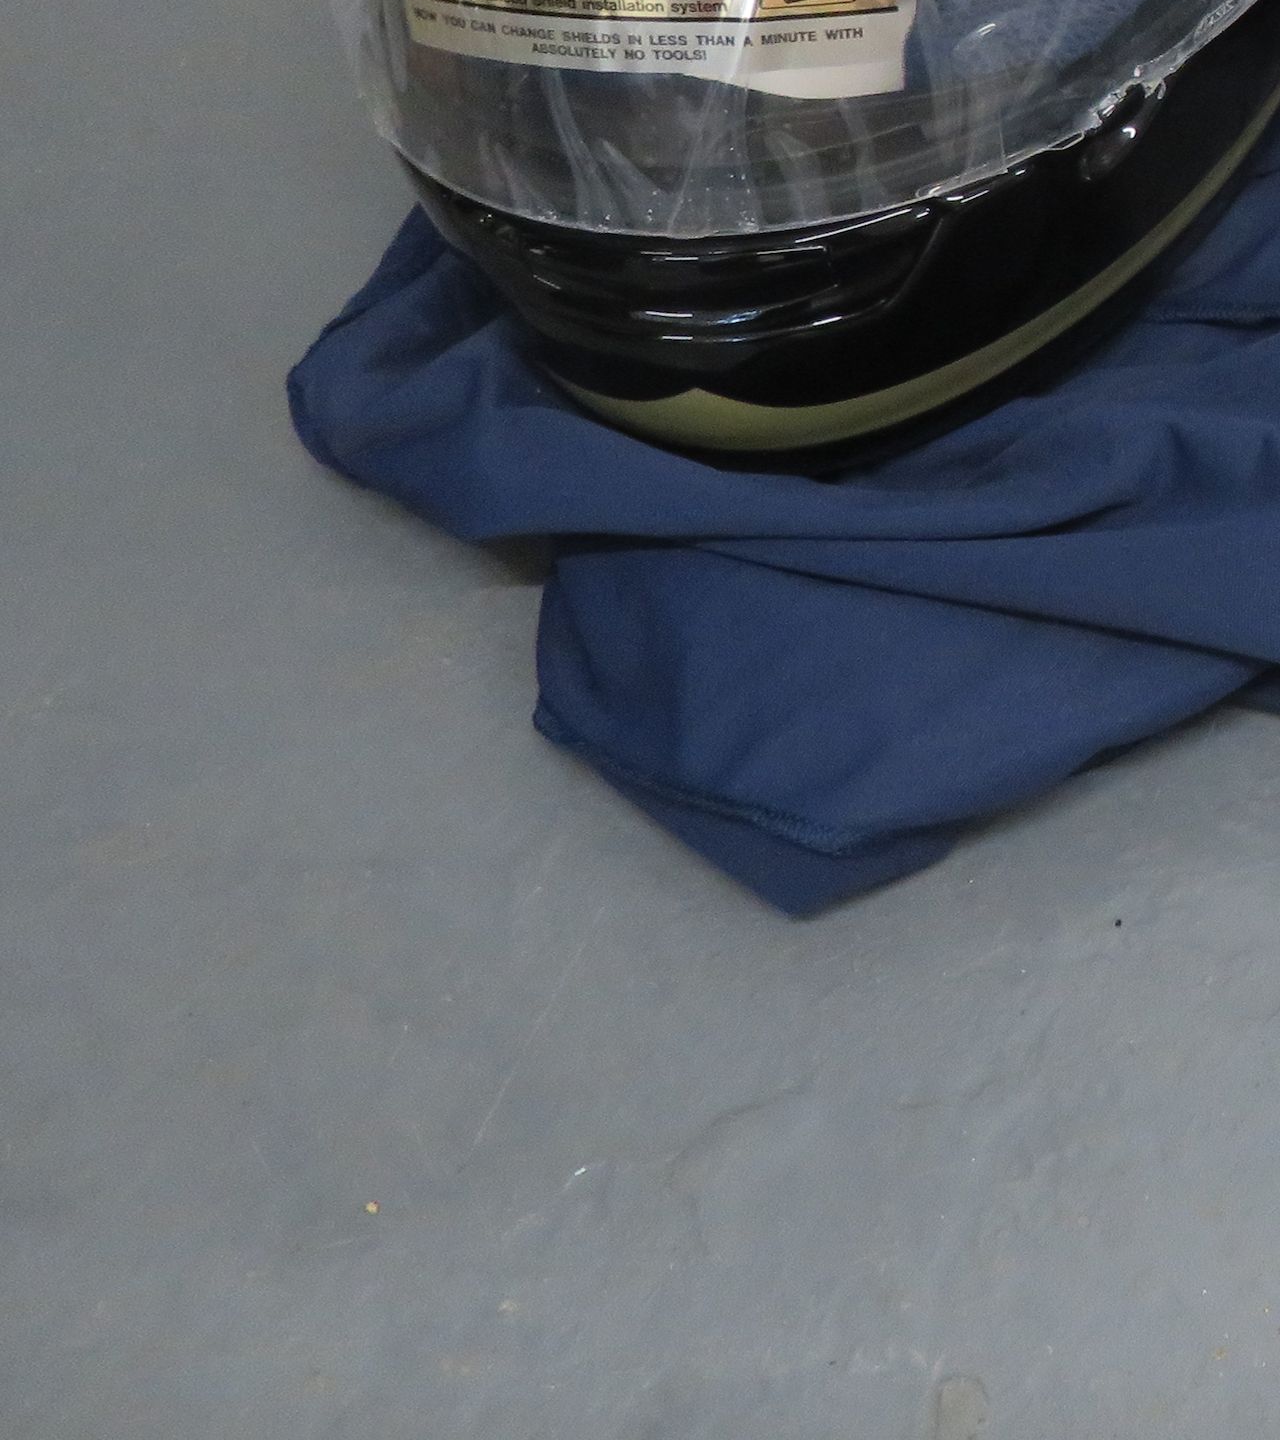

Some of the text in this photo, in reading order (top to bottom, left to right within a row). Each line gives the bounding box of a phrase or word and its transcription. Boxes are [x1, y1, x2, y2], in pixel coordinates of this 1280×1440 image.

[582, 0, 664, 12] installation
[671, 1, 727, 14] system
[443, 14, 466, 29] YOU
[470, 20, 496, 33] CAN
[501, 25, 555, 41] CHANGE
[563, 31, 621, 45] SHIELDS
[628, 34, 642, 45] IN
[649, 35, 688, 46] LESS
[696, 35, 736, 46] THAN
[743, 35, 753, 47] A
[761, 32, 817, 45] MINUTE
[825, 28, 863, 40] WITH
[532, 43, 707, 60] ABSOLUTELY NO TOOLS!
